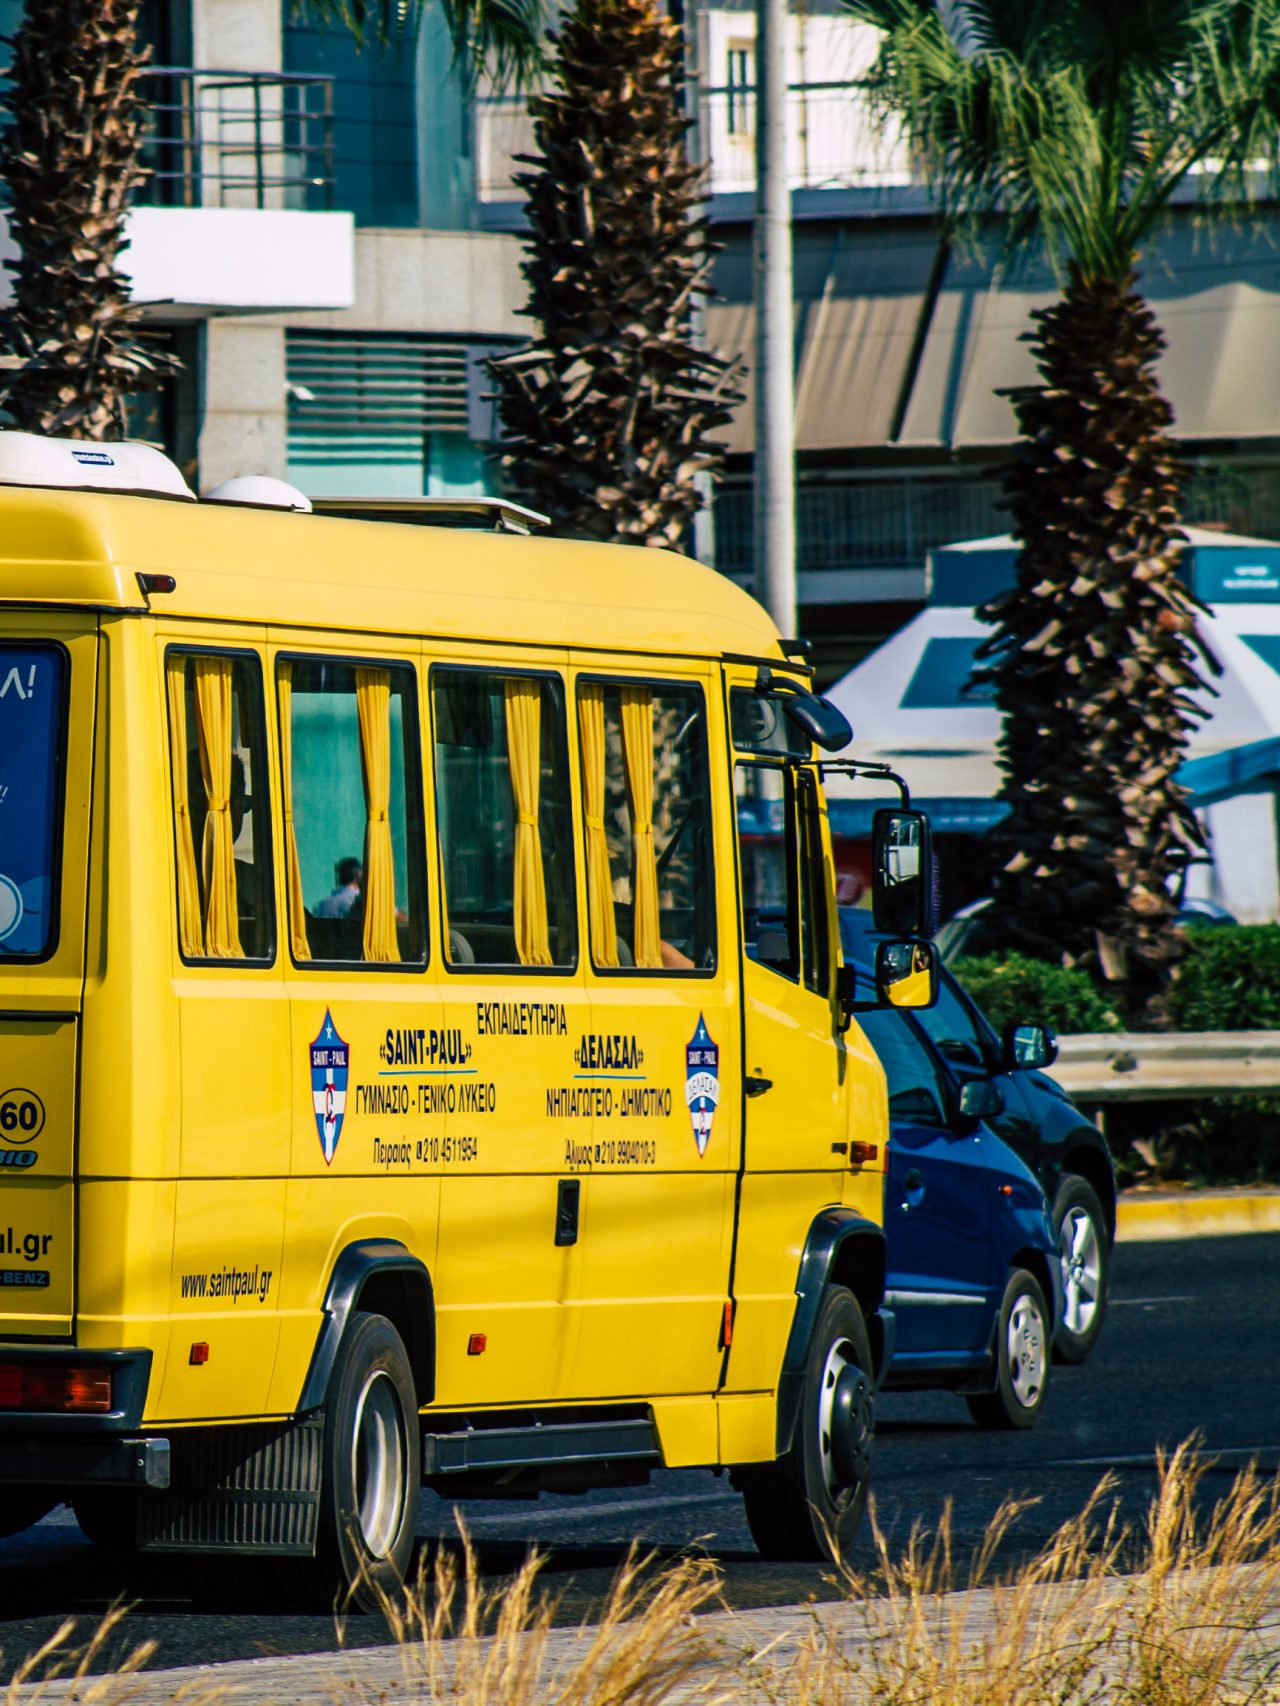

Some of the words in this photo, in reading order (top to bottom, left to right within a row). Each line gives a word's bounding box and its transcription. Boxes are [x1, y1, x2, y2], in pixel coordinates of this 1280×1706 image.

[477, 1002, 568, 1036] ΕΚΠΑΙΔΕΥΤΗΡΙΑ
[379, 1028, 472, 1066] «SAINT-PAUL»
[574, 1034, 644, 1070] «ΔΕΛΑΣΑΛ»
[355, 1084, 409, 1115] ΓΥΜΝΑΣΙΟ
[418, 1083, 456, 1114] ΓΕΝΙΚΟ
[458, 1082, 496, 1113] ΛΥΚΕΙΟ
[546, 1087, 613, 1118] ΝΗΠΙΑΓΩΓΕΙΟ
[620, 1087, 672, 1117] ΔΗΜΟΤΙΚΟ
[0, 1101, 38, 1131] 60
[373, 1135, 412, 1171] Πειραιάς
[423, 1137, 439, 1163] 210
[441, 1136, 478, 1163] 4511954
[601, 1140, 616, 1165] 210
[181, 1264, 273, 1305] www.saintpaul.gr
